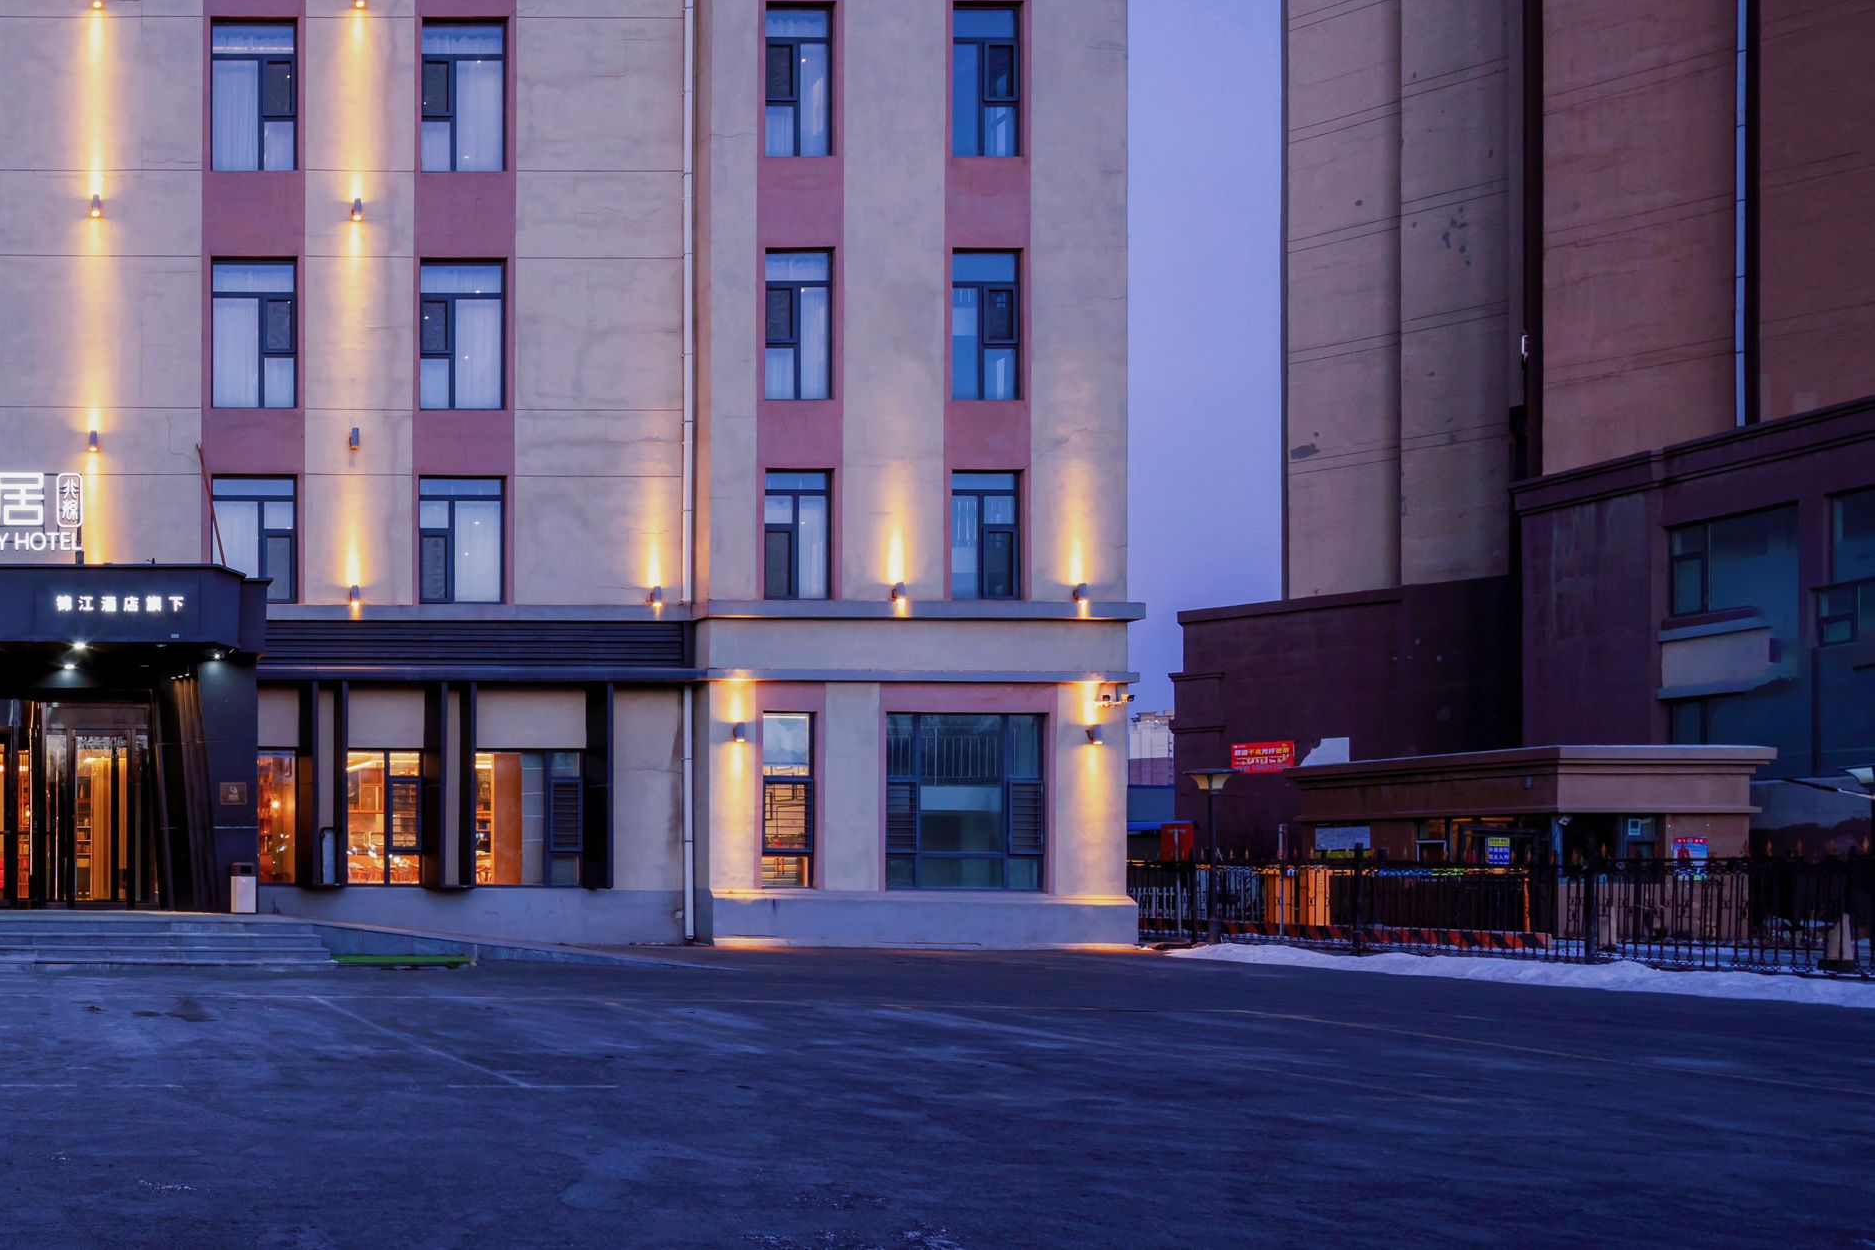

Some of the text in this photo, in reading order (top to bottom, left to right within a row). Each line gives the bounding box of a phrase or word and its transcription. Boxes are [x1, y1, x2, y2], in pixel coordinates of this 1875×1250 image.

[14, 532, 83, 551] HOTEL
[55, 595, 185, 613] 锦江酒店旗下
